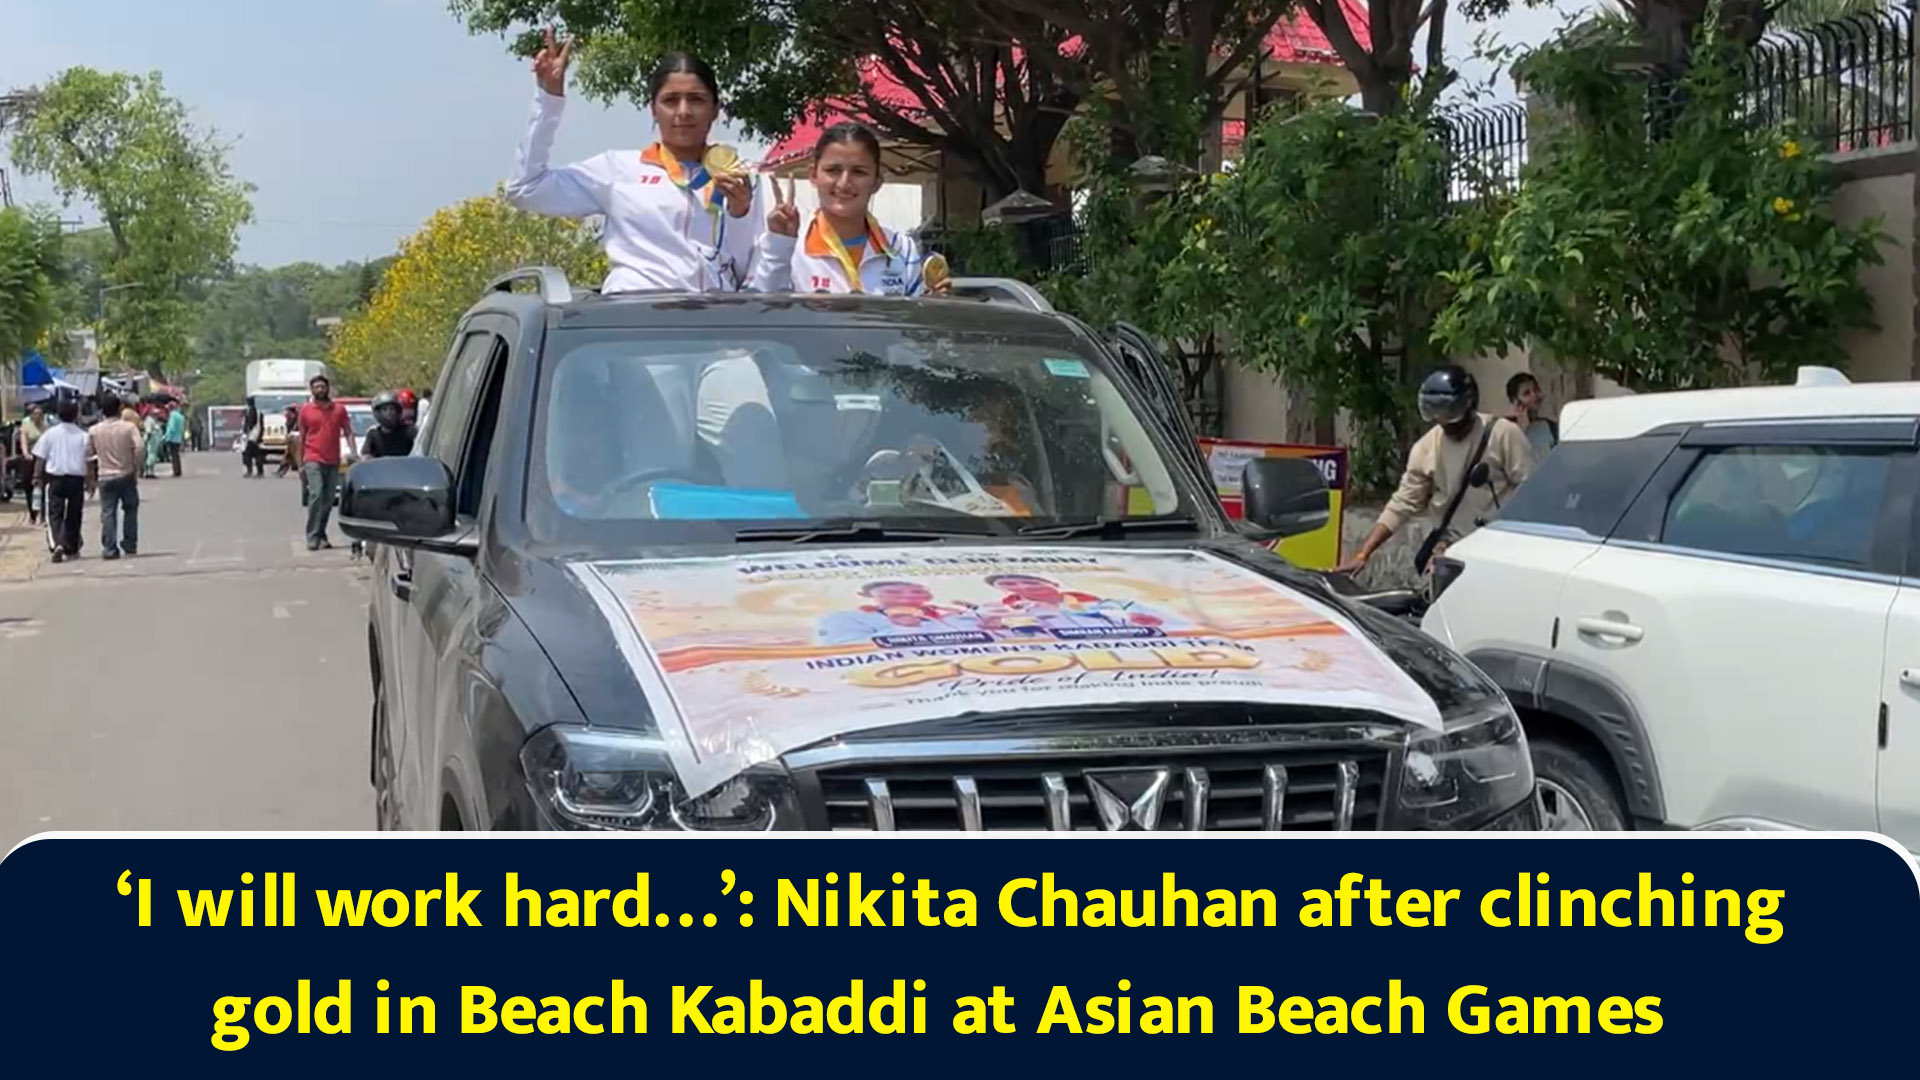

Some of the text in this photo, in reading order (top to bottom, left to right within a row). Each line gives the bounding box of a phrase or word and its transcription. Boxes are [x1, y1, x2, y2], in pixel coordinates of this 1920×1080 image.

[806, 651, 903, 669] INDIAN
[912, 643, 1046, 658] WOMEN'S
[1053, 639, 1177, 650] KABADDI
[844, 651, 1262, 688] GOLD
[938, 669, 1219, 690] Pride of India!
[906, 690, 969, 705] Thank
[978, 687, 1016, 698] you
[1021, 684, 1052, 693] for
